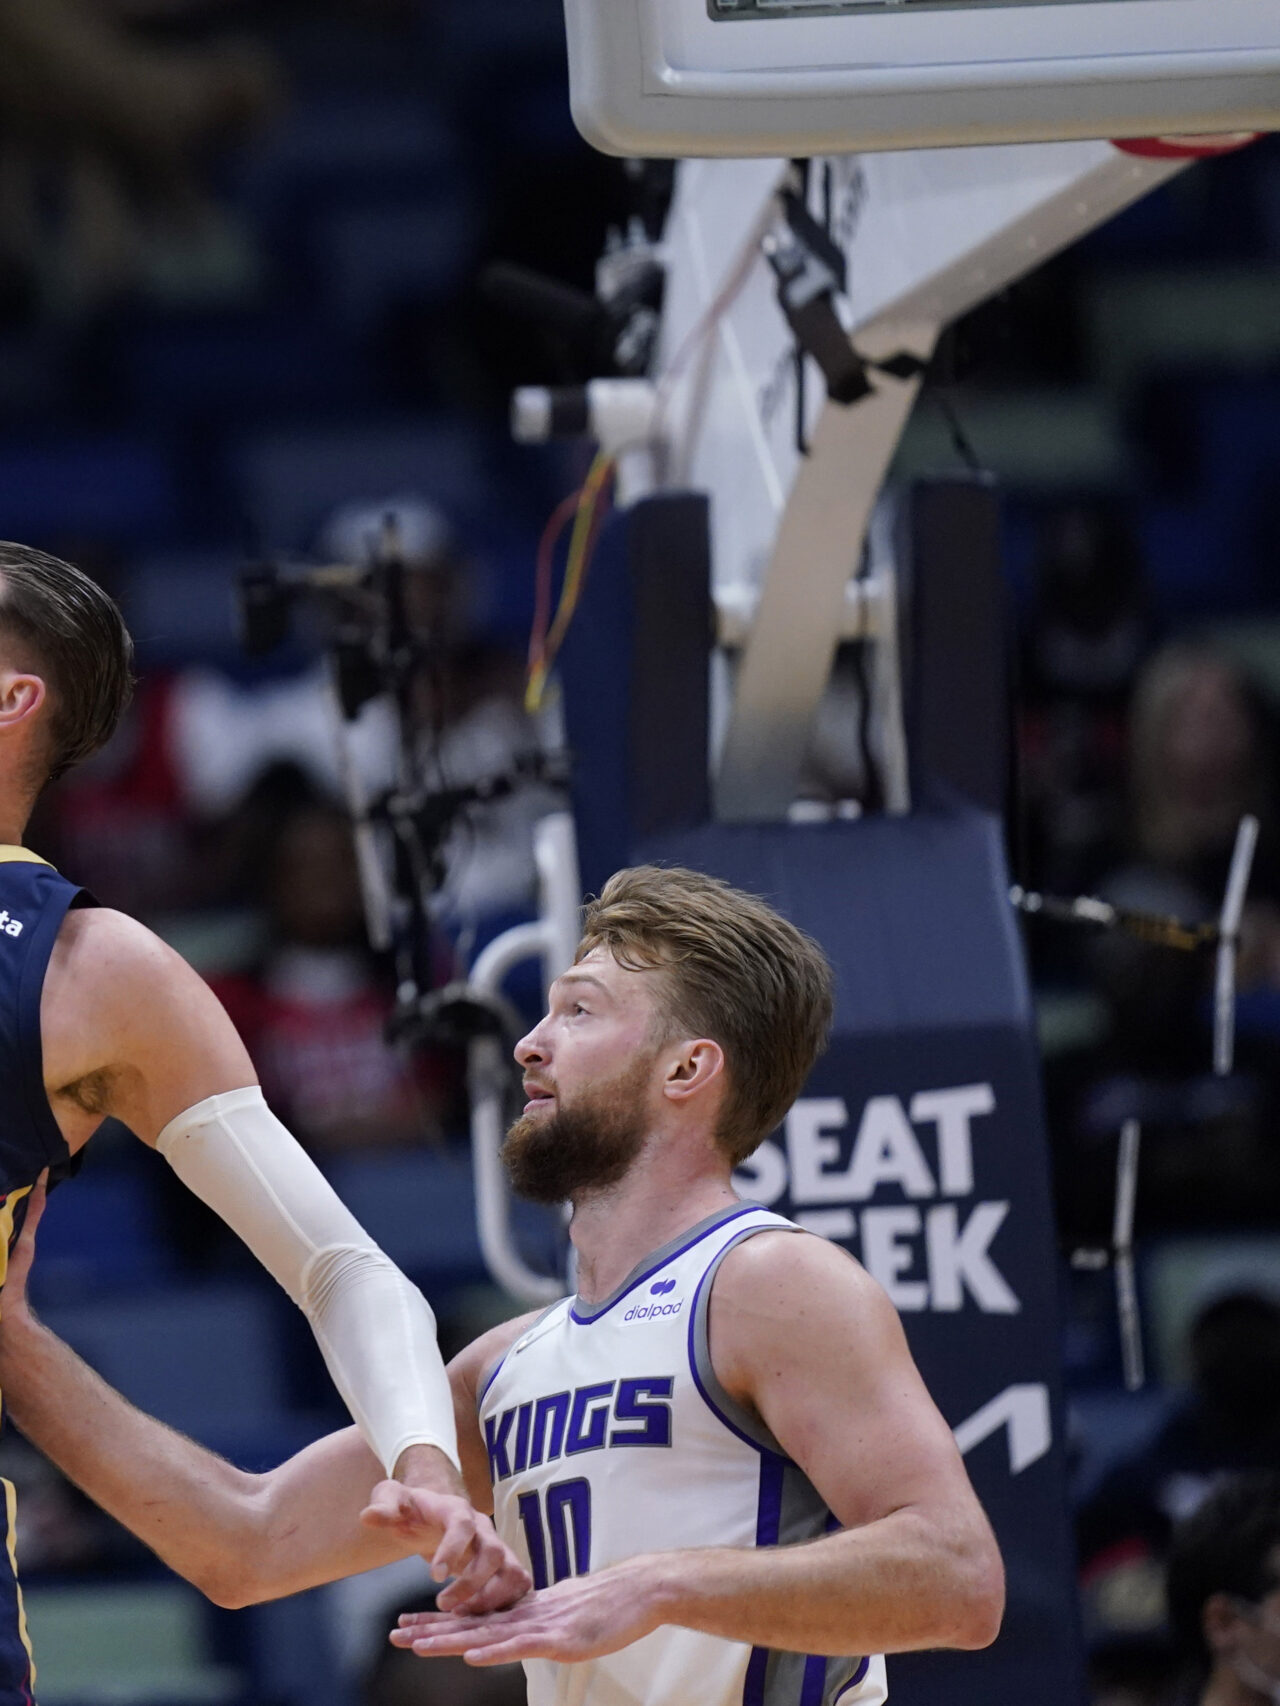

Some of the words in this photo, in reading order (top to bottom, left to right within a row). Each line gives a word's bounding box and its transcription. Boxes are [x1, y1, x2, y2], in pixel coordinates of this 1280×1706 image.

[623, 1297, 685, 1322] dialpad
[483, 1375, 675, 1486] KINGS
[517, 1475, 592, 1591] 10
